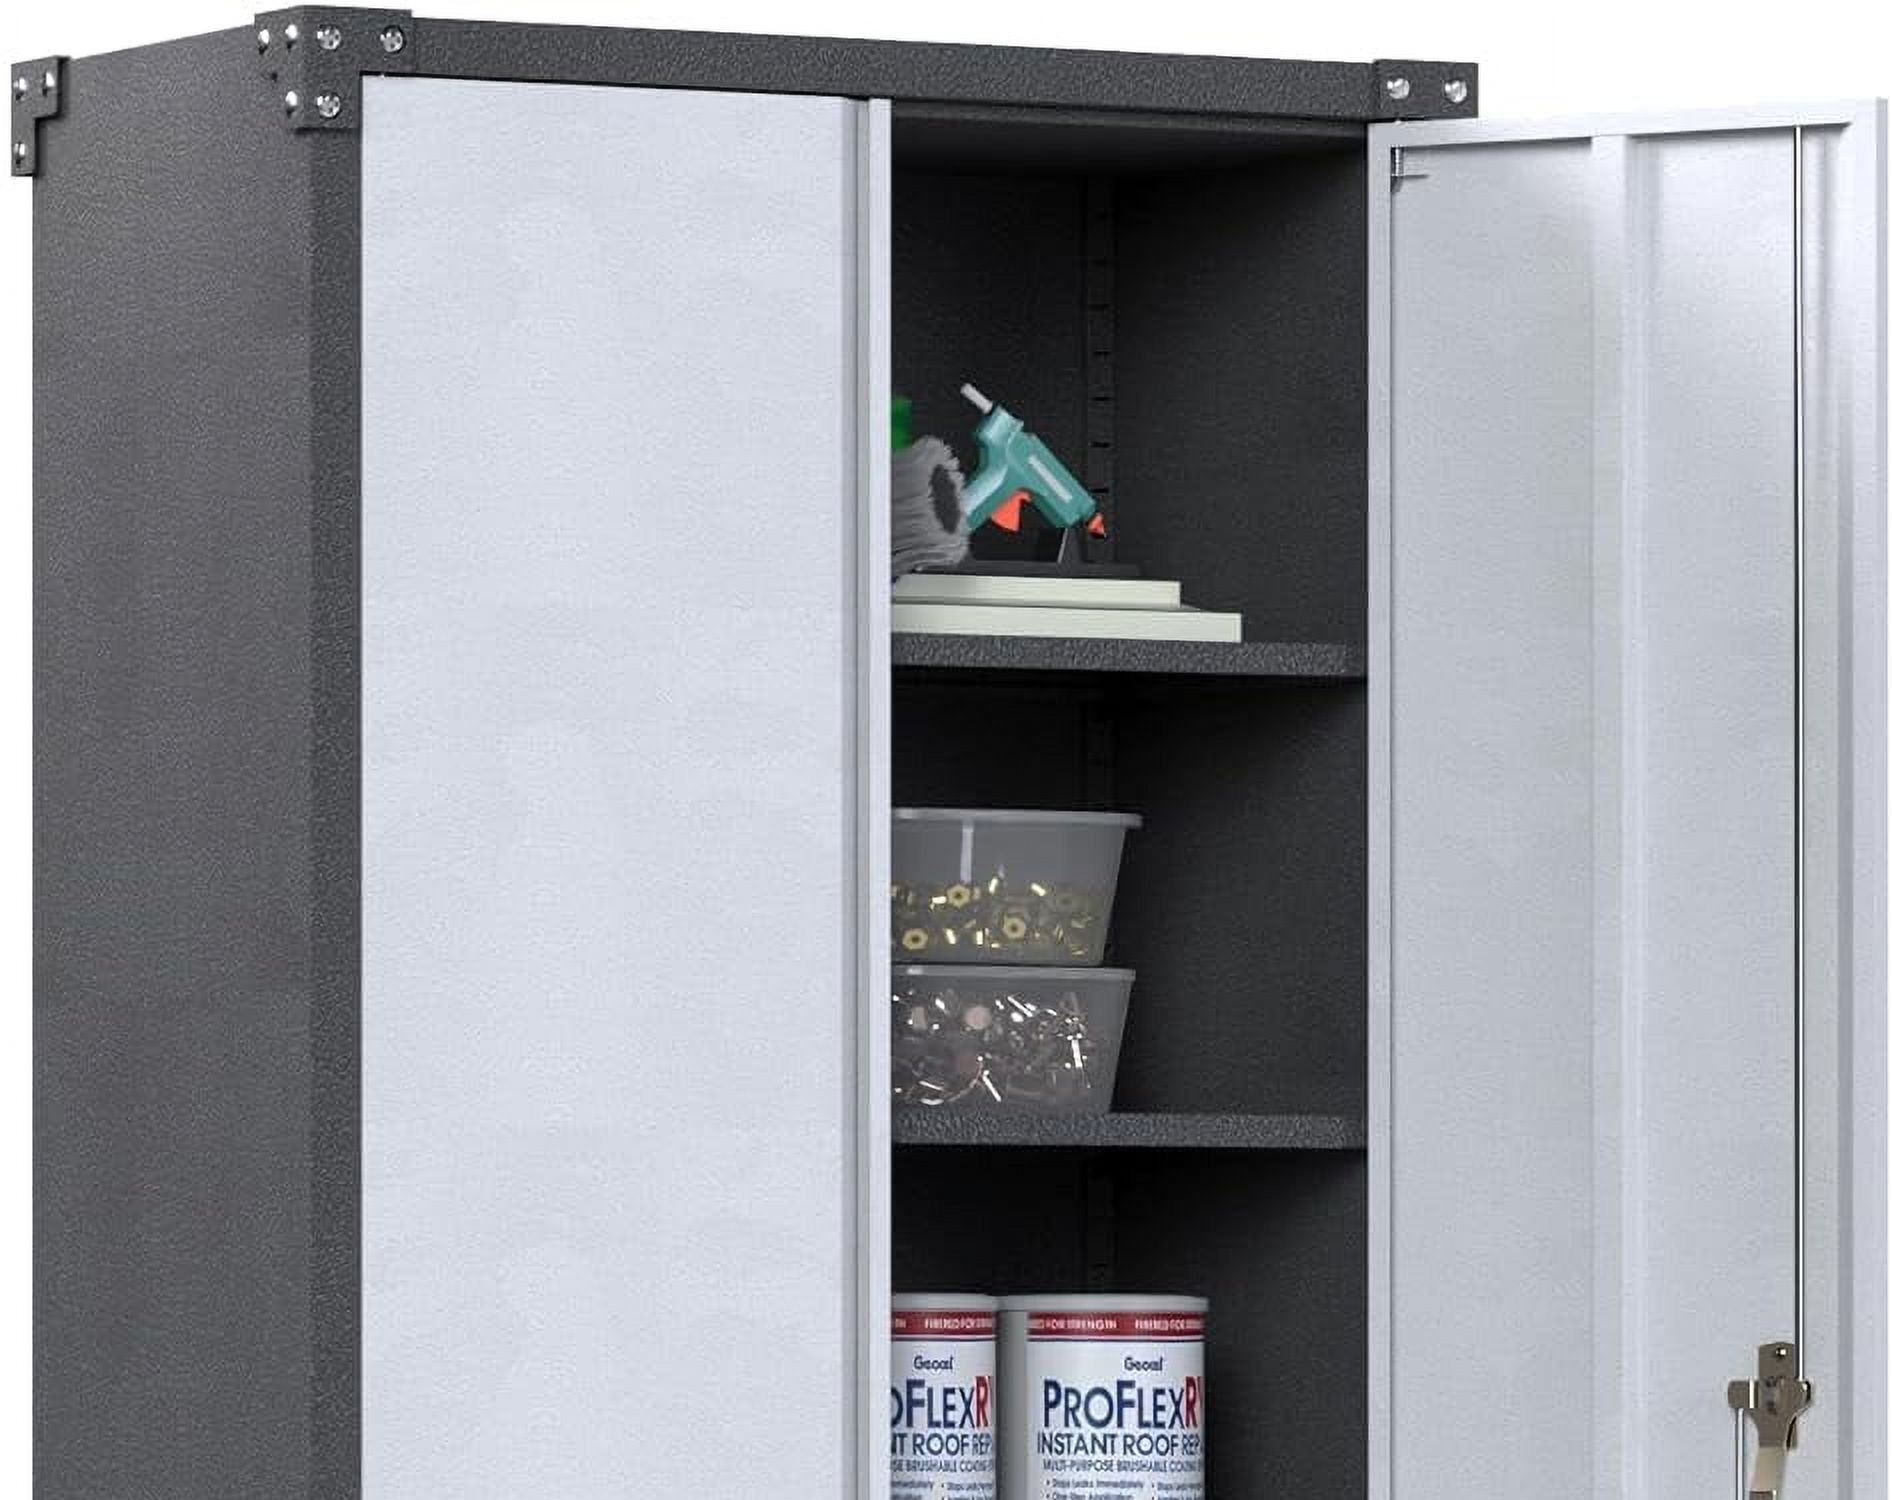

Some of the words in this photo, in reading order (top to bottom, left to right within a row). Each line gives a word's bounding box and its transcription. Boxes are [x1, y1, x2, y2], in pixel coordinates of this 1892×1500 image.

[1043, 1375, 1203, 1429] PROFLEXR
[912, 1432, 969, 1457] ROOF
[1037, 1432, 1118, 1457] INSTANT
[1123, 1432, 1179, 1457] ROOF
